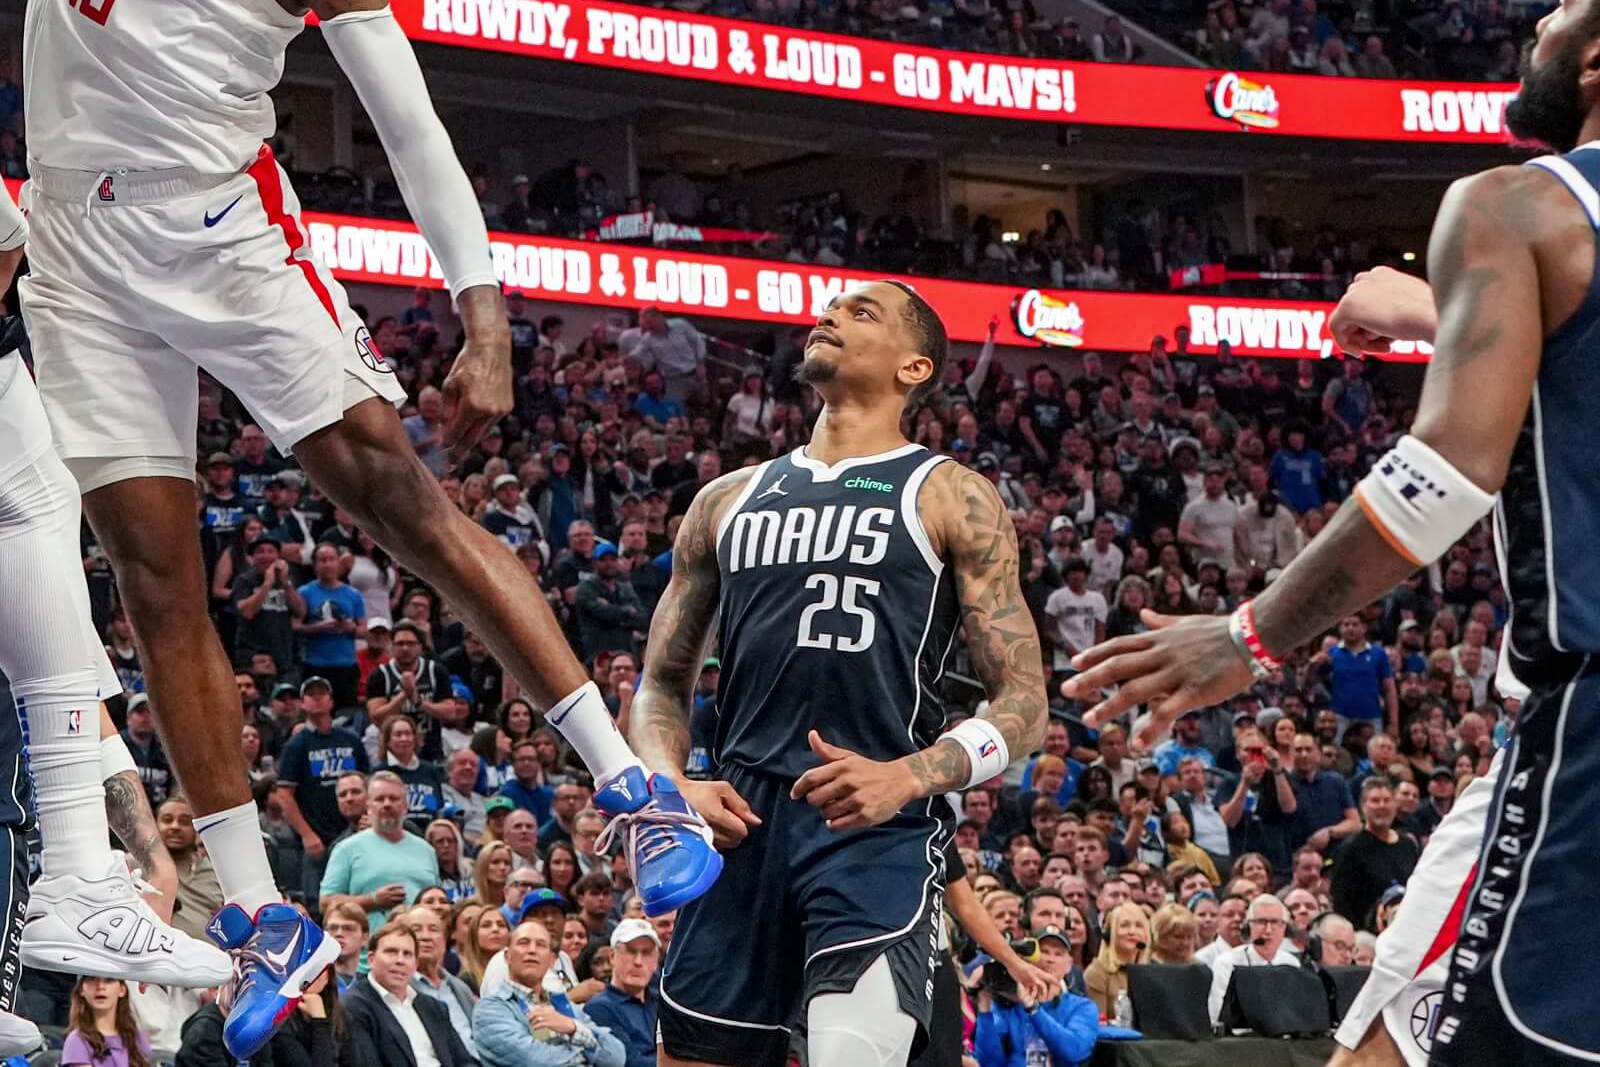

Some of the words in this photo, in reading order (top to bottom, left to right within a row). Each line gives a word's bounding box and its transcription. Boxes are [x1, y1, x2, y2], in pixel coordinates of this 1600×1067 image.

[587, 9, 718, 70] PROUD
[728, 30, 756, 74] &
[764, 35, 862, 89] LOUD
[894, 54, 941, 100] GO
[949, 60, 1077, 113] MAVS!
[1402, 90, 1516, 133] ROW
[309, 221, 440, 281] ROWD
[495, 242, 590, 294] ROUD
[599, 254, 627, 297] &
[633, 256, 729, 308] LOUD
[757, 269, 804, 315] GO
[1189, 305, 1333, 358] ROWDY,
[844, 476, 894, 493] chime
[730, 505, 894, 572] MAVS
[795, 572, 881, 653] 25
[77, 905, 175, 954] AIR
